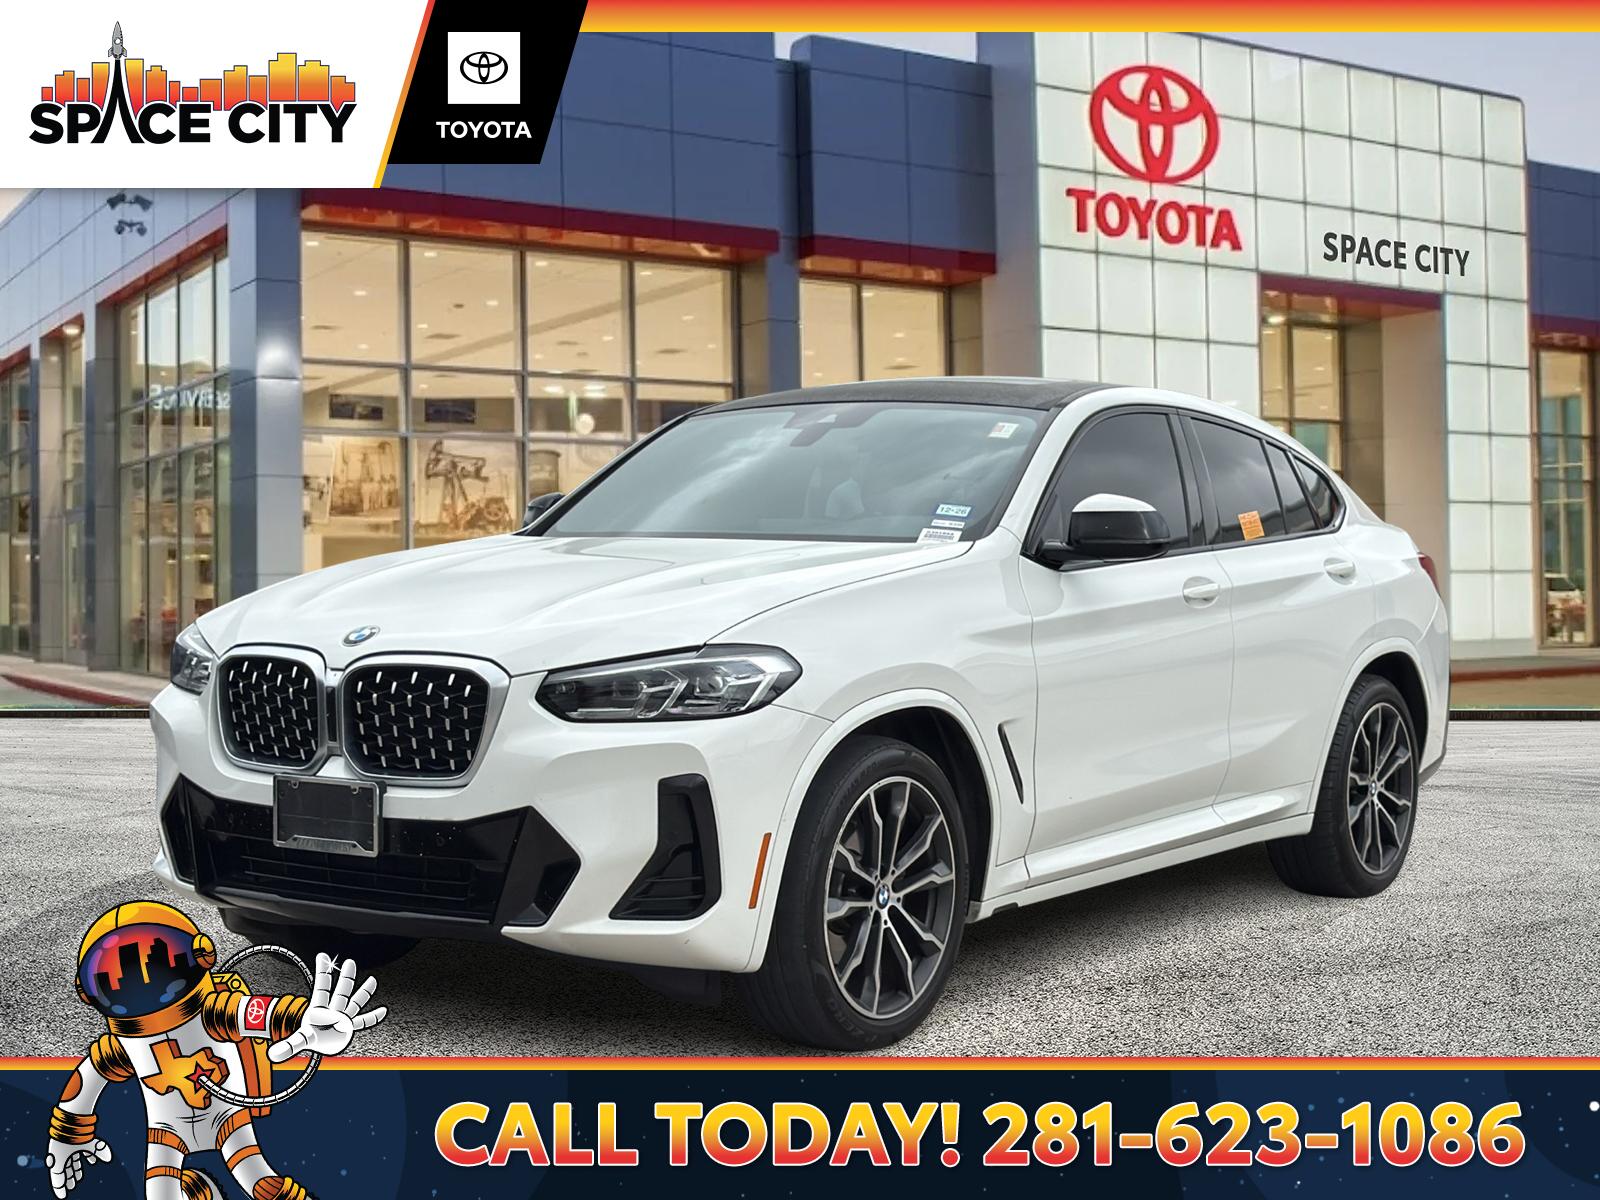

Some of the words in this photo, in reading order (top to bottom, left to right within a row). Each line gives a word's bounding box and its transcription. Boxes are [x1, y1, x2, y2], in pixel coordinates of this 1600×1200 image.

[1066, 188, 1242, 251] TOYOTA
[1323, 232, 1406, 270] SPACE
[1414, 245, 1470, 277] CITY
